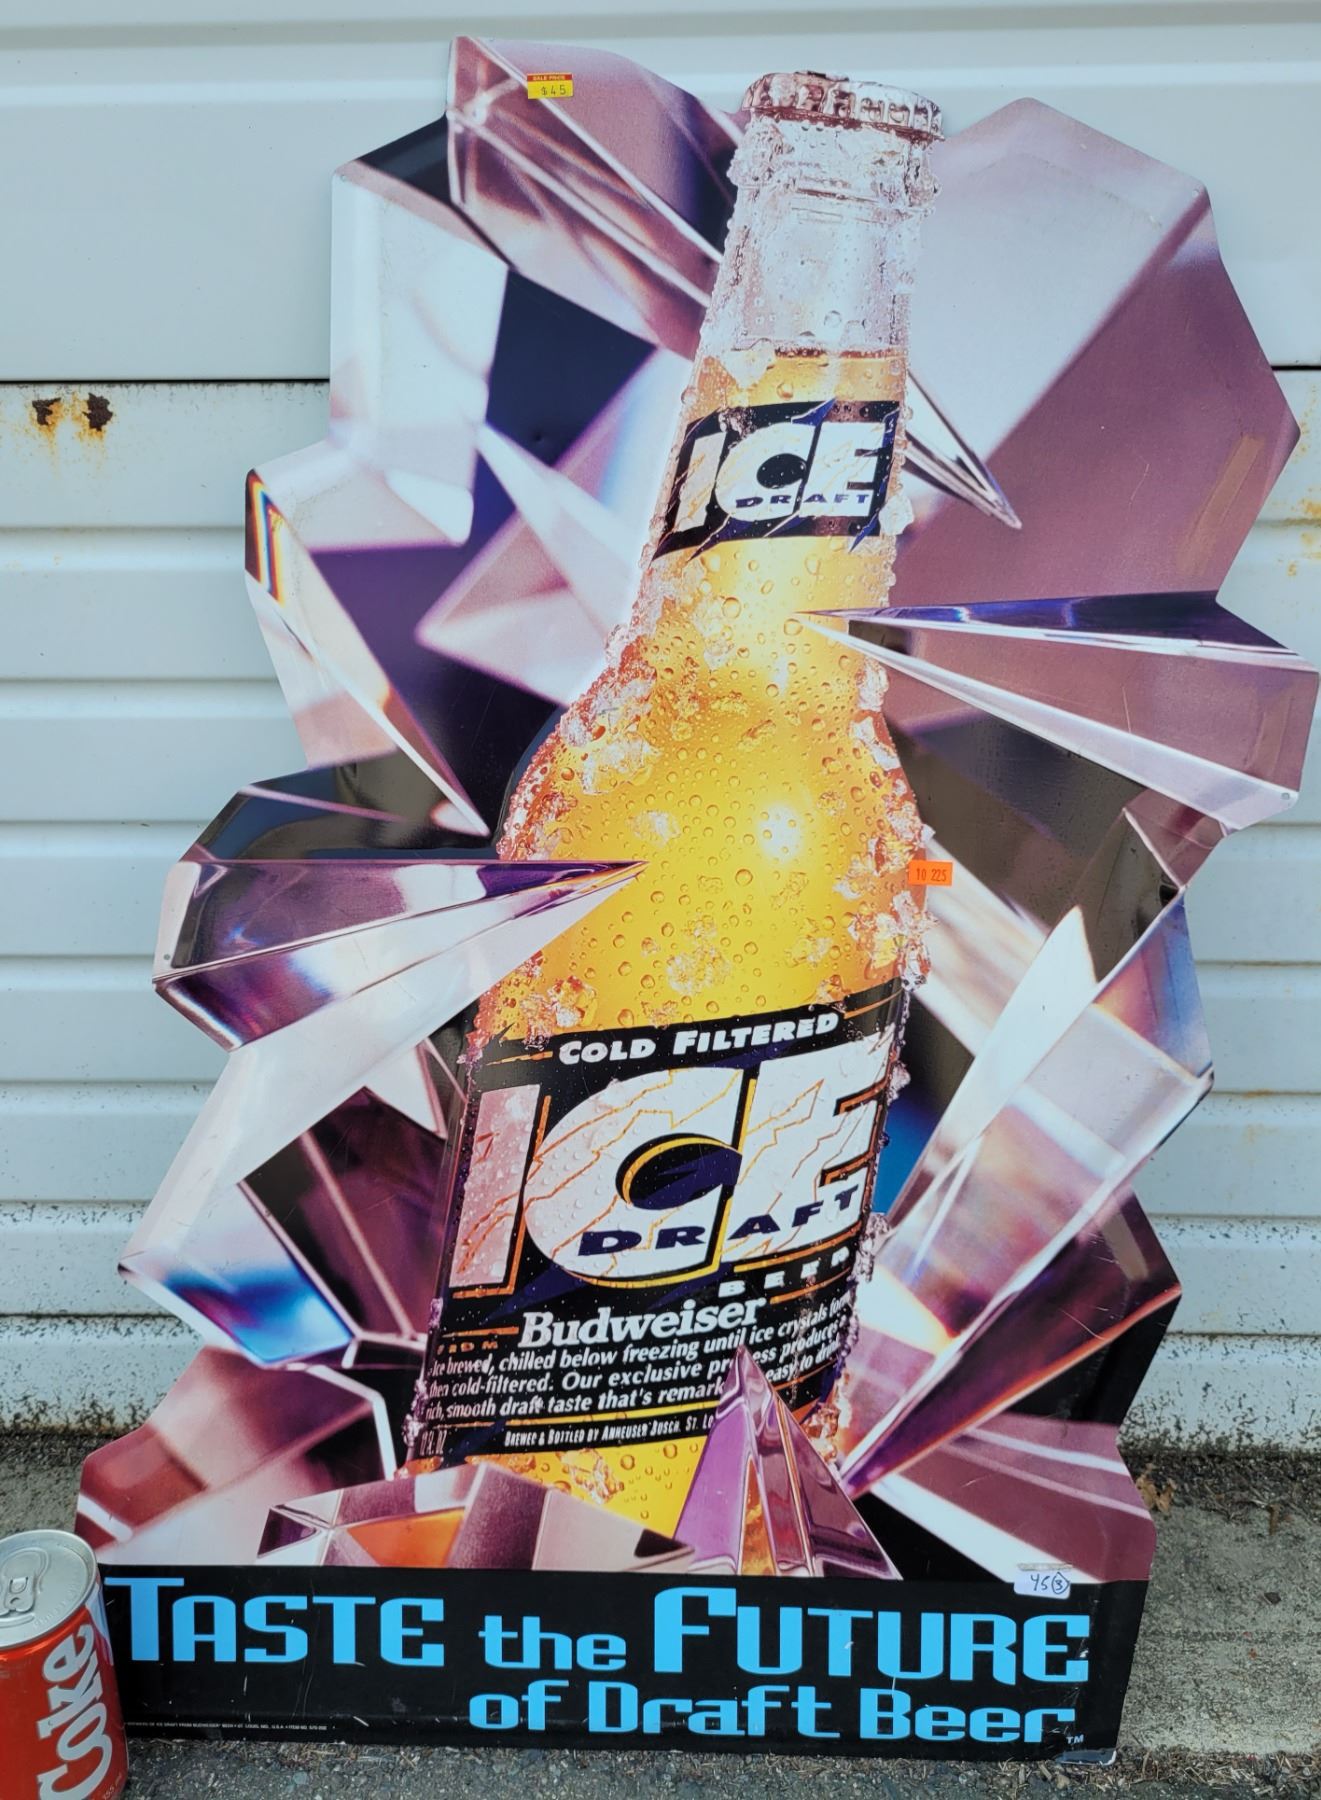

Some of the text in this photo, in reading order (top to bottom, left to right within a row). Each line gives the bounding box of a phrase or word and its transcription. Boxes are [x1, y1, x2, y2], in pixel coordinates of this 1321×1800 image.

[674, 421, 887, 532] ICE
[735, 493, 870, 509] DRAFT
[558, 1013, 840, 1065] COLD FILTERED
[448, 1023, 896, 1289] ICE
[576, 1185, 859, 1257] DRAFT
[446, 1352, 495, 1376] brewed,
[498, 1349, 557, 1372] chilled
[559, 1347, 618, 1369] below
[622, 1338, 700, 1365] freezing
[703, 1327, 747, 1354] until
[749, 1326, 775, 1345] ice
[777, 1303, 829, 1339] crystals
[517, 1297, 767, 1348] Budweiser
[446, 1397, 497, 1418] smooth
[547, 1395, 593, 1413] taste
[597, 1387, 653, 1411] that's
[800, 1353, 814, 1372] to
[561, 1371, 603, 1392] Our
[608, 1361, 703, 1388] exclusive
[1030, 1573, 1050, 1591] 45
[105, 1577, 445, 1667] TASTE
[478, 1615, 627, 1671] the
[654, 1586, 1091, 1686] FUTURE
[36, 1623, 113, 1800] Coke
[469, 1679, 570, 1731] of
[588, 1680, 840, 1739] Draft
[860, 1687, 1076, 1744] Beer
